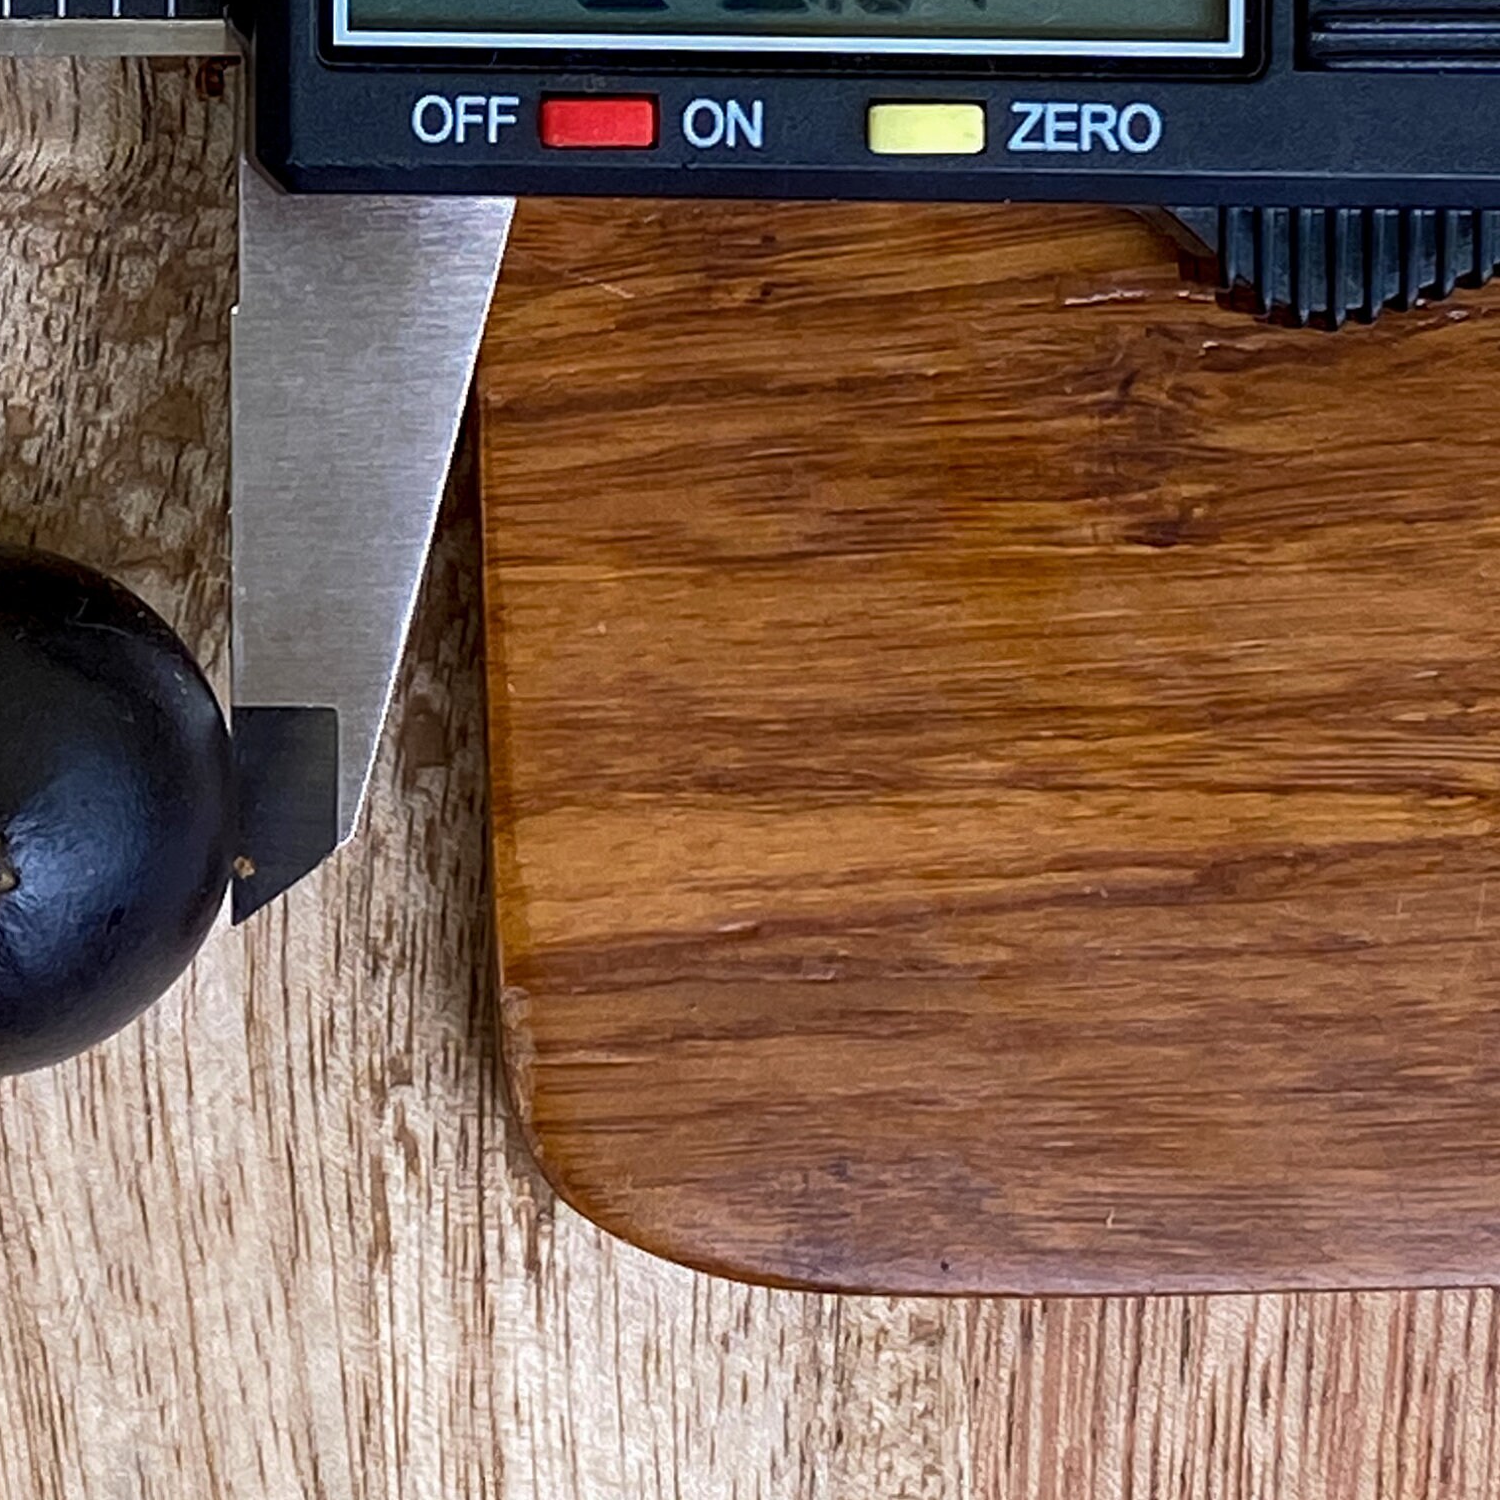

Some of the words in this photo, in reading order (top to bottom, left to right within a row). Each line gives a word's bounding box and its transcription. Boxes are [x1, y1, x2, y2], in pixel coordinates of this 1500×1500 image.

[411, 94, 520, 145] OFF
[681, 97, 764, 149] ON
[1006, 102, 1163, 154] ZERO
